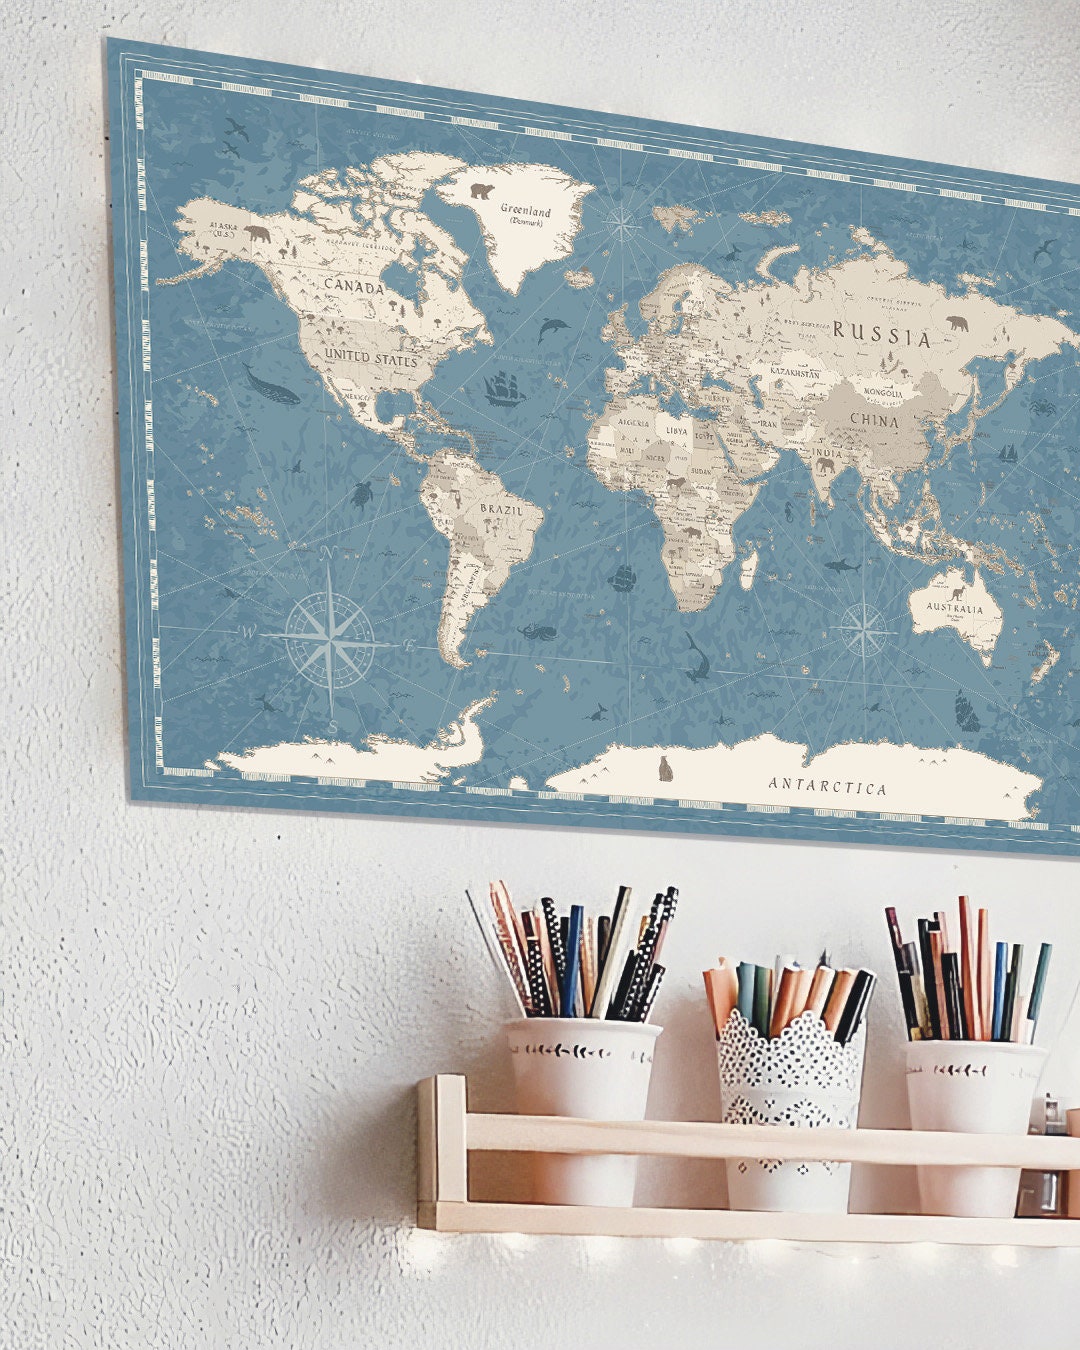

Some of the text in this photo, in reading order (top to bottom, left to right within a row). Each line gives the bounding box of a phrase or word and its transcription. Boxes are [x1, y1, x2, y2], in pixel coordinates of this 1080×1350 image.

[500, 202, 552, 218] Greenland
[209, 221, 238, 231] ALASKA
[213, 230, 235, 239] (U.S.)
[324, 278, 384, 296] CANADA
[833, 320, 930, 349] RUSSIA
[324, 348, 418, 369] UNITED STATES
[770, 366, 820, 379] KAZAKHSTAN
[864, 387, 903, 399] MONGOLIA
[618, 418, 649, 428] ALGERIA
[760, 420, 777, 429] IRAN
[850, 412, 899, 429] CHINA
[666, 426, 688, 436] LIBYA
[812, 447, 843, 459] INDIA
[691, 467, 712, 476] SUDAN
[480, 503, 523, 517] BRAZIL
[926, 602, 983, 615] AUSTRALIA
[327, 719, 338, 734] S
[768, 776, 887, 796] ANTARCTICA
